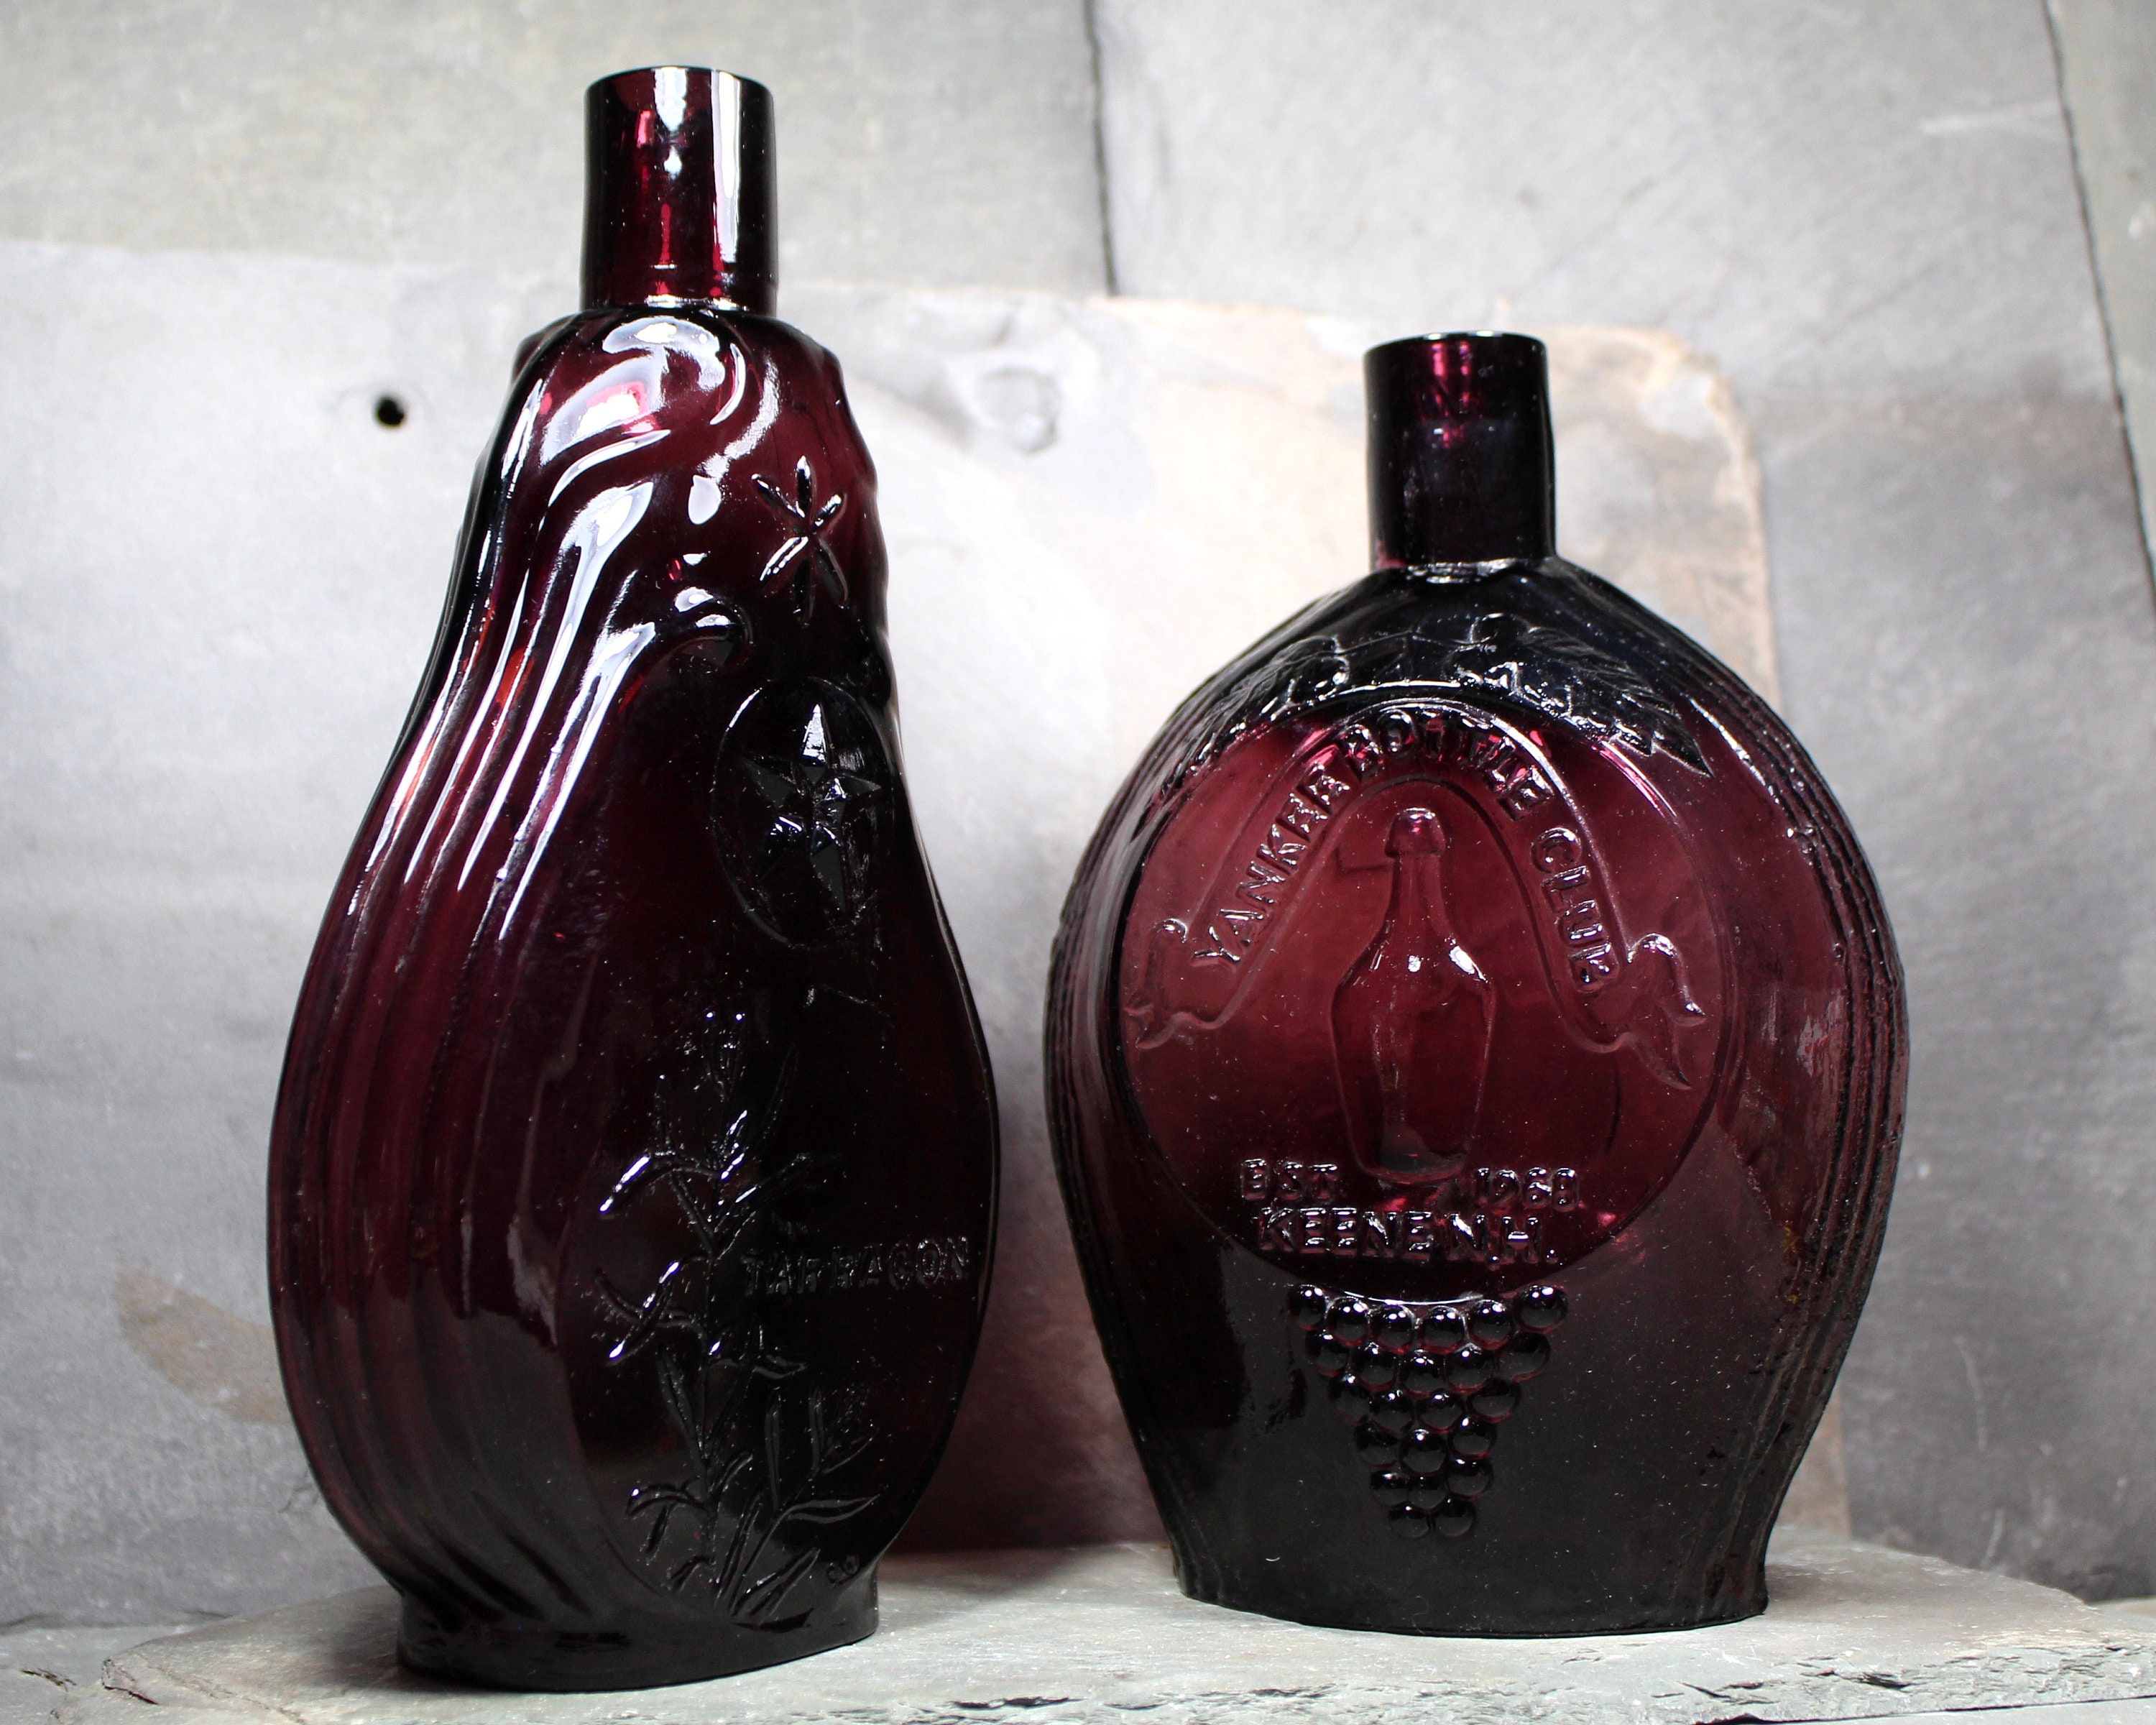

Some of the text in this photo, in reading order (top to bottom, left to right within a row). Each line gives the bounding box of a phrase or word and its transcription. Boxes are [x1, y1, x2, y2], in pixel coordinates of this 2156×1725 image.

[1192, 706, 1621, 995] YANKEE BOTTLE CLUB
[741, 1235, 970, 1297] TARRAGON
